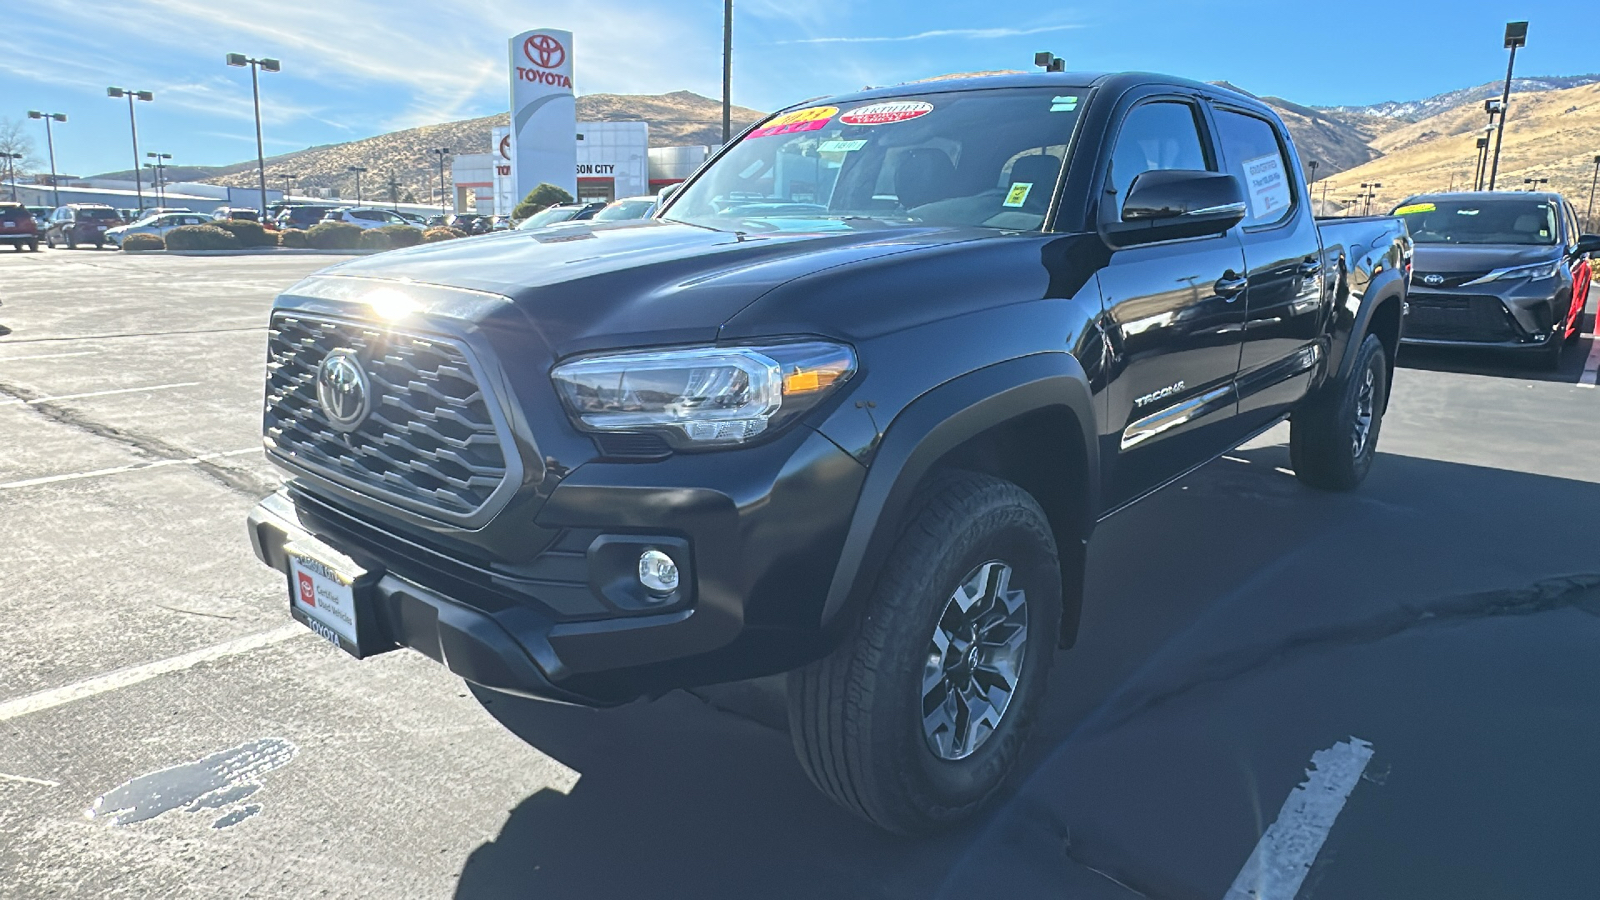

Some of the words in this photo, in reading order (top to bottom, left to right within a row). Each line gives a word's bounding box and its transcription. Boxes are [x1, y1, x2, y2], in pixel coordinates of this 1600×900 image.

[516, 66, 572, 89] TOYOTA
[853, 104, 927, 115] CERTIFIED
[594, 164, 614, 174] CITY
[1135, 381, 1185, 407] TACOMA
[316, 585, 339, 605] Certified
[318, 597, 331, 612] Used
[331, 606, 353, 626] Vehicles
[307, 618, 341, 648] TOYOTA
